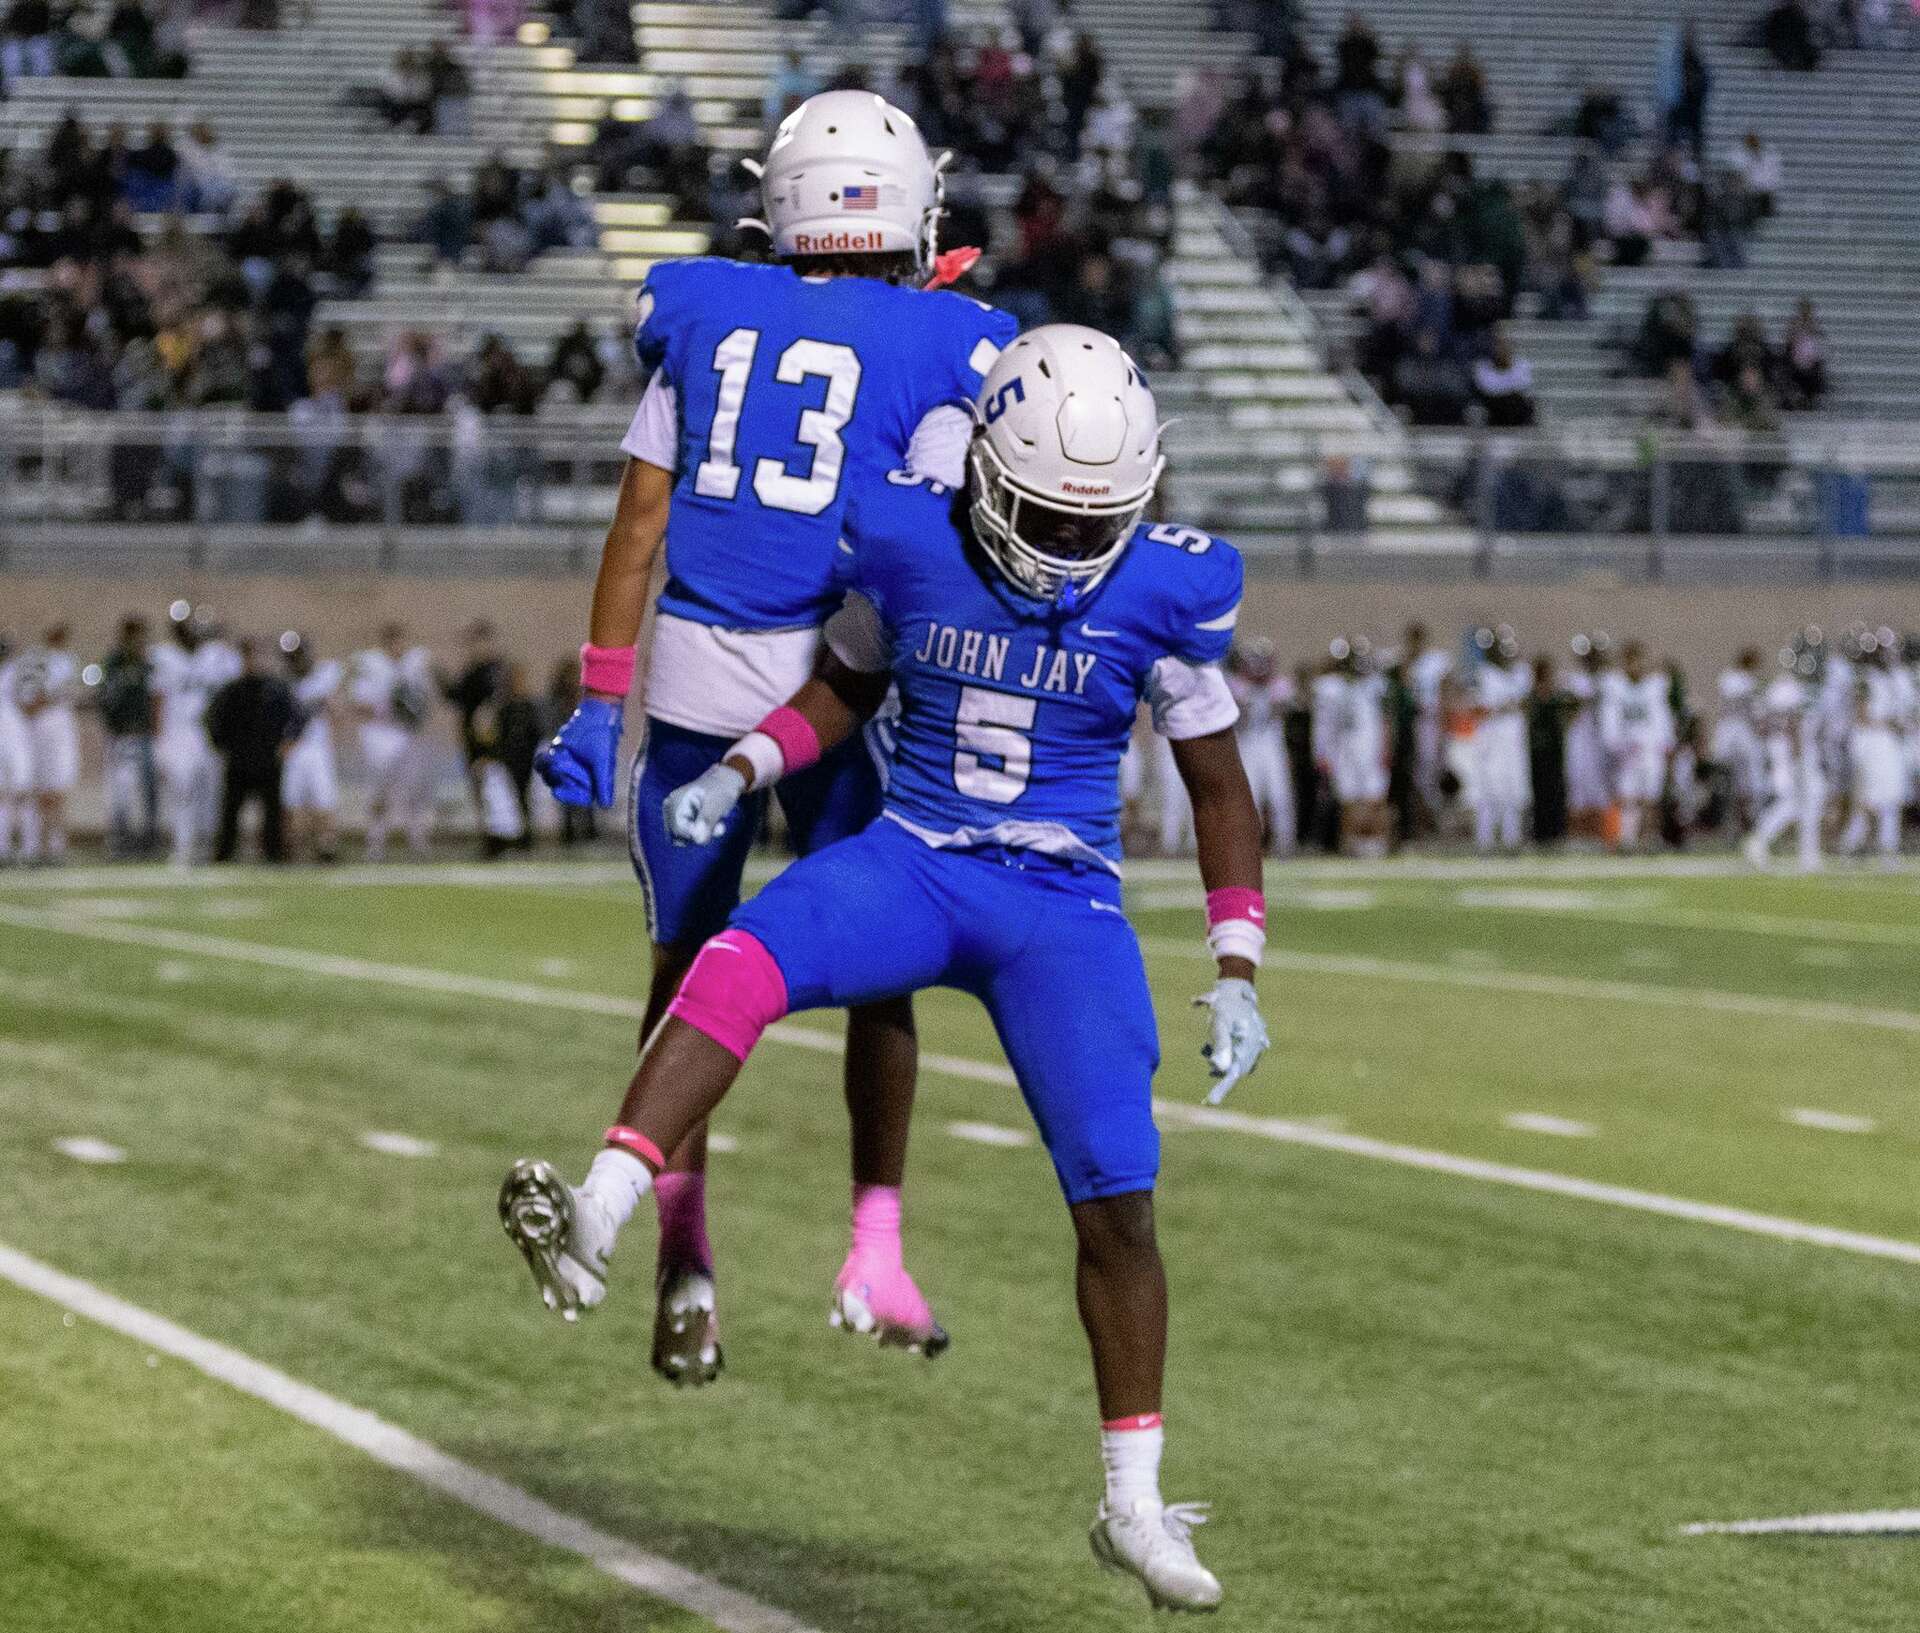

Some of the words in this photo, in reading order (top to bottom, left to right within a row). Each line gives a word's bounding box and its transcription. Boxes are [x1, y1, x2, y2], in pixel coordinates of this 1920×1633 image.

[794, 231, 883, 252] Riddell
[694, 327, 863, 515] 13
[984, 376, 1026, 425] 5
[1061, 482, 1111, 496] Riddell
[1147, 523, 1212, 554] 5
[915, 621, 1011, 681] JOHN
[1020, 646, 1096, 694] JAY
[952, 685, 1037, 804] 5
